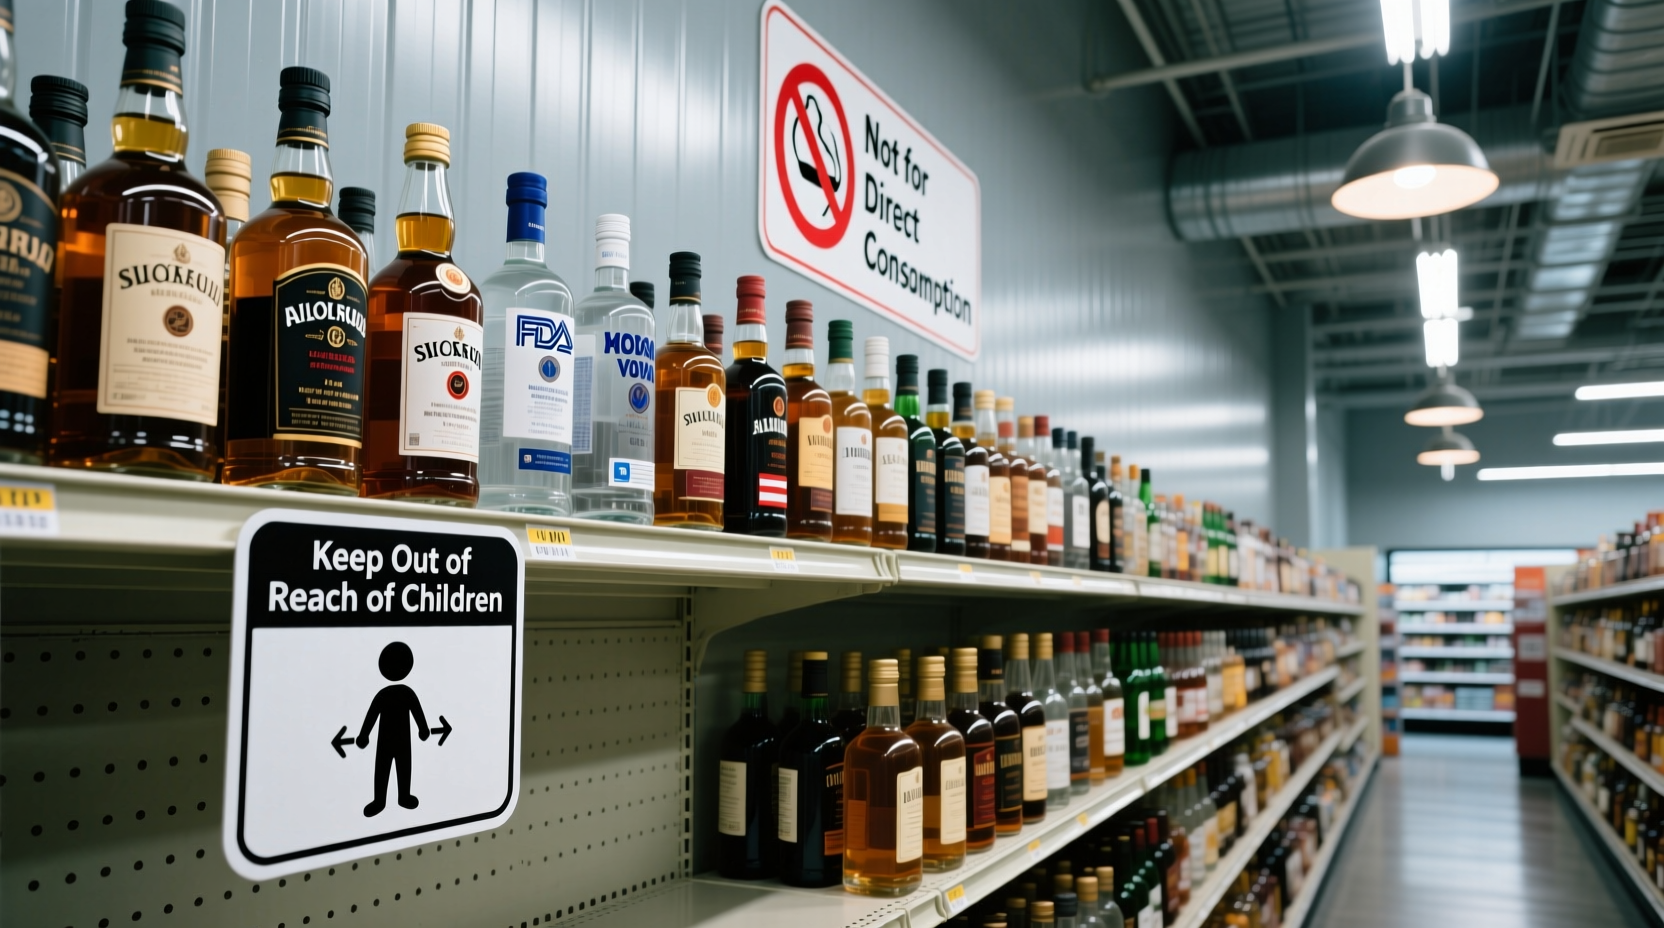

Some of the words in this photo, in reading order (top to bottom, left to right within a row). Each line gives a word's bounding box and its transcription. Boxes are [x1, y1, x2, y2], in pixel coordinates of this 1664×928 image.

[865, 114, 899, 176] Not
[904, 148, 929, 196] for
[865, 172, 920, 243] Direct
[516, 314, 573, 355] FDA
[312, 540, 384, 580] Keep
[391, 543, 440, 575] Out
[445, 546, 473, 575] of
[268, 580, 358, 612] Reach
[366, 582, 396, 612] of
[401, 583, 503, 613] Children
